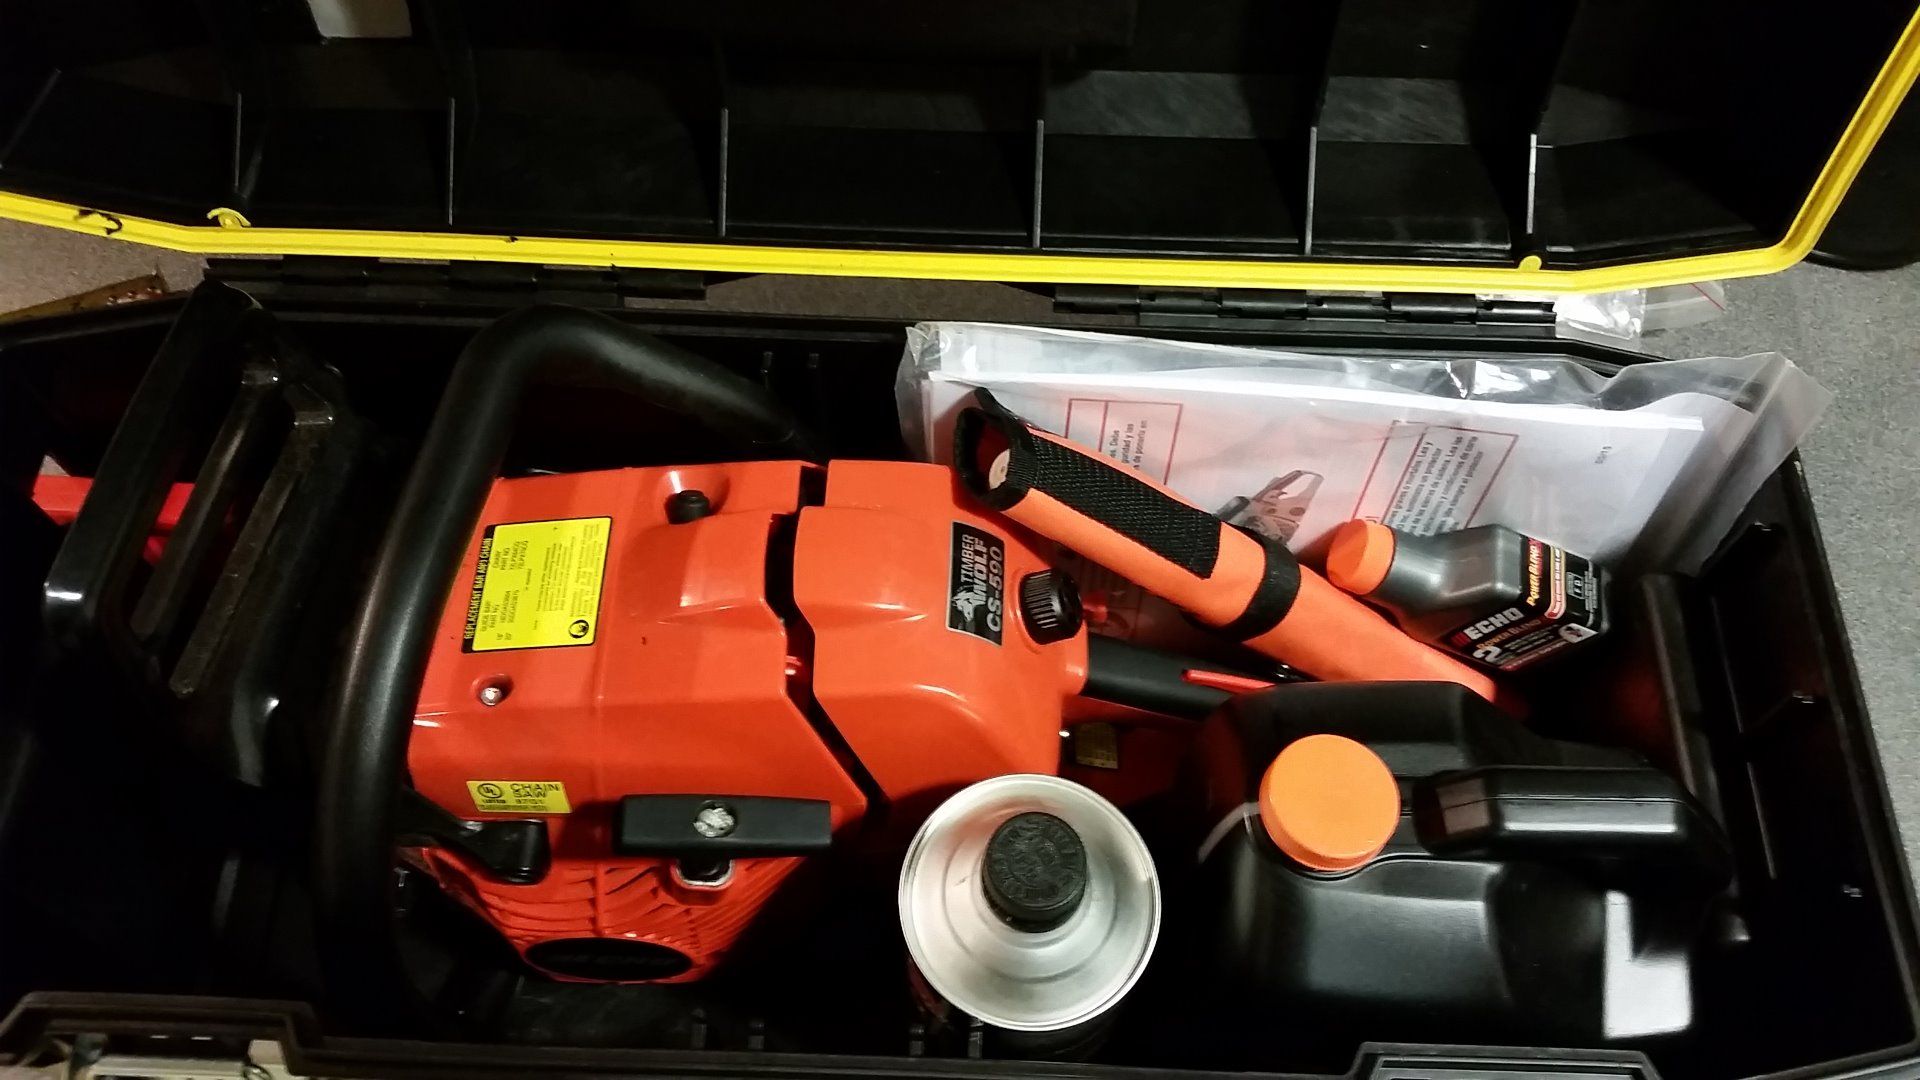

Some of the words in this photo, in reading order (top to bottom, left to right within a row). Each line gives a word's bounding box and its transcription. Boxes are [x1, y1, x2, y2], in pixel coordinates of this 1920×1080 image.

[961, 534, 974, 583] TIMBER
[973, 538, 987, 599] WOLF
[464, 590, 483, 639] REPLACEMENT
[474, 575, 484, 588] BAR
[479, 538, 492, 558] CHAIN
[987, 547, 1002, 632] CS-590
[1463, 607, 1525, 640] ECHO
[510, 783, 560, 791] CHAIN
[513, 789, 546, 798] SAW
